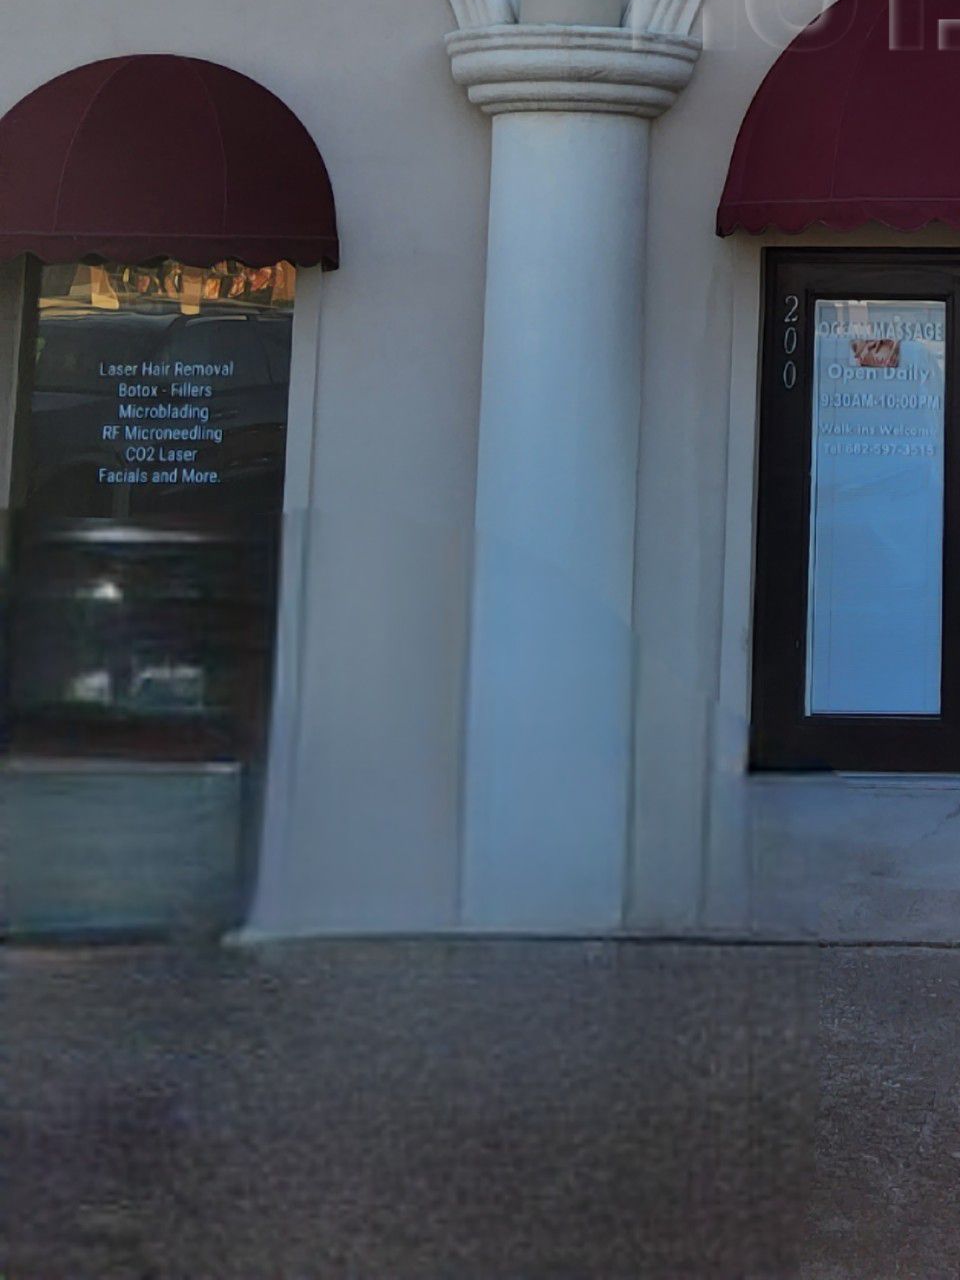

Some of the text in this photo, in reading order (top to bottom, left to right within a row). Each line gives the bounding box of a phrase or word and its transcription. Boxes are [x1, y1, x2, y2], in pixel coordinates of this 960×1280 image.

[873, 321, 945, 342] MASSAGE
[782, 295, 800, 390] 200
[99, 361, 234, 377] Laser Hair Removal
[828, 363, 930, 386] Open Daily
[118, 382, 158, 398] Botox
[171, 382, 212, 398] Fillers
[118, 404, 210, 422] Microblading
[102, 425, 223, 443] RF Microneedling
[125, 447, 198, 462] CO2 Laser
[98, 468, 221, 484] Facials and More.
